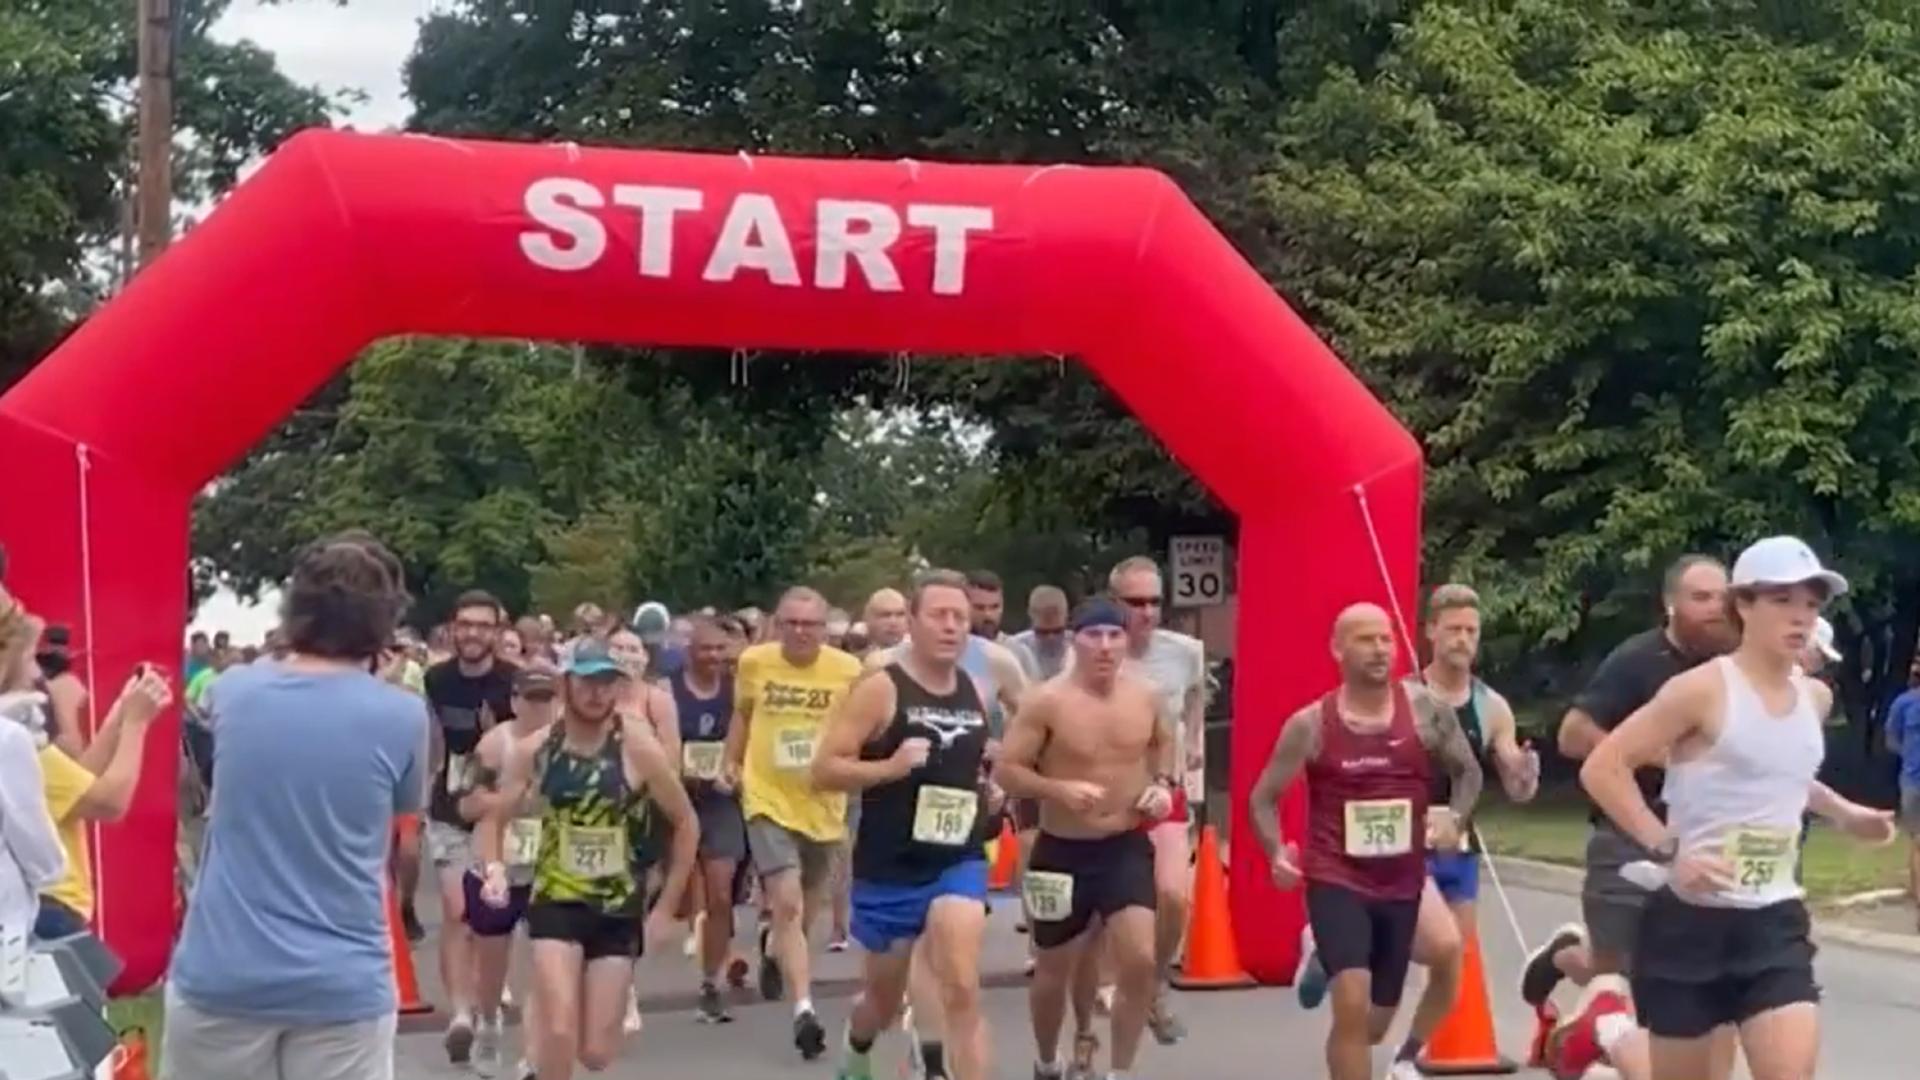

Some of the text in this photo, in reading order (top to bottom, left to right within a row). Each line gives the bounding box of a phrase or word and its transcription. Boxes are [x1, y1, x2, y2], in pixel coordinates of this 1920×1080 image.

[519, 177, 994, 294] START
[1176, 541, 1221, 554] SPEED
[1180, 555, 1215, 568] LIMIT
[1178, 572, 1219, 598] 30
